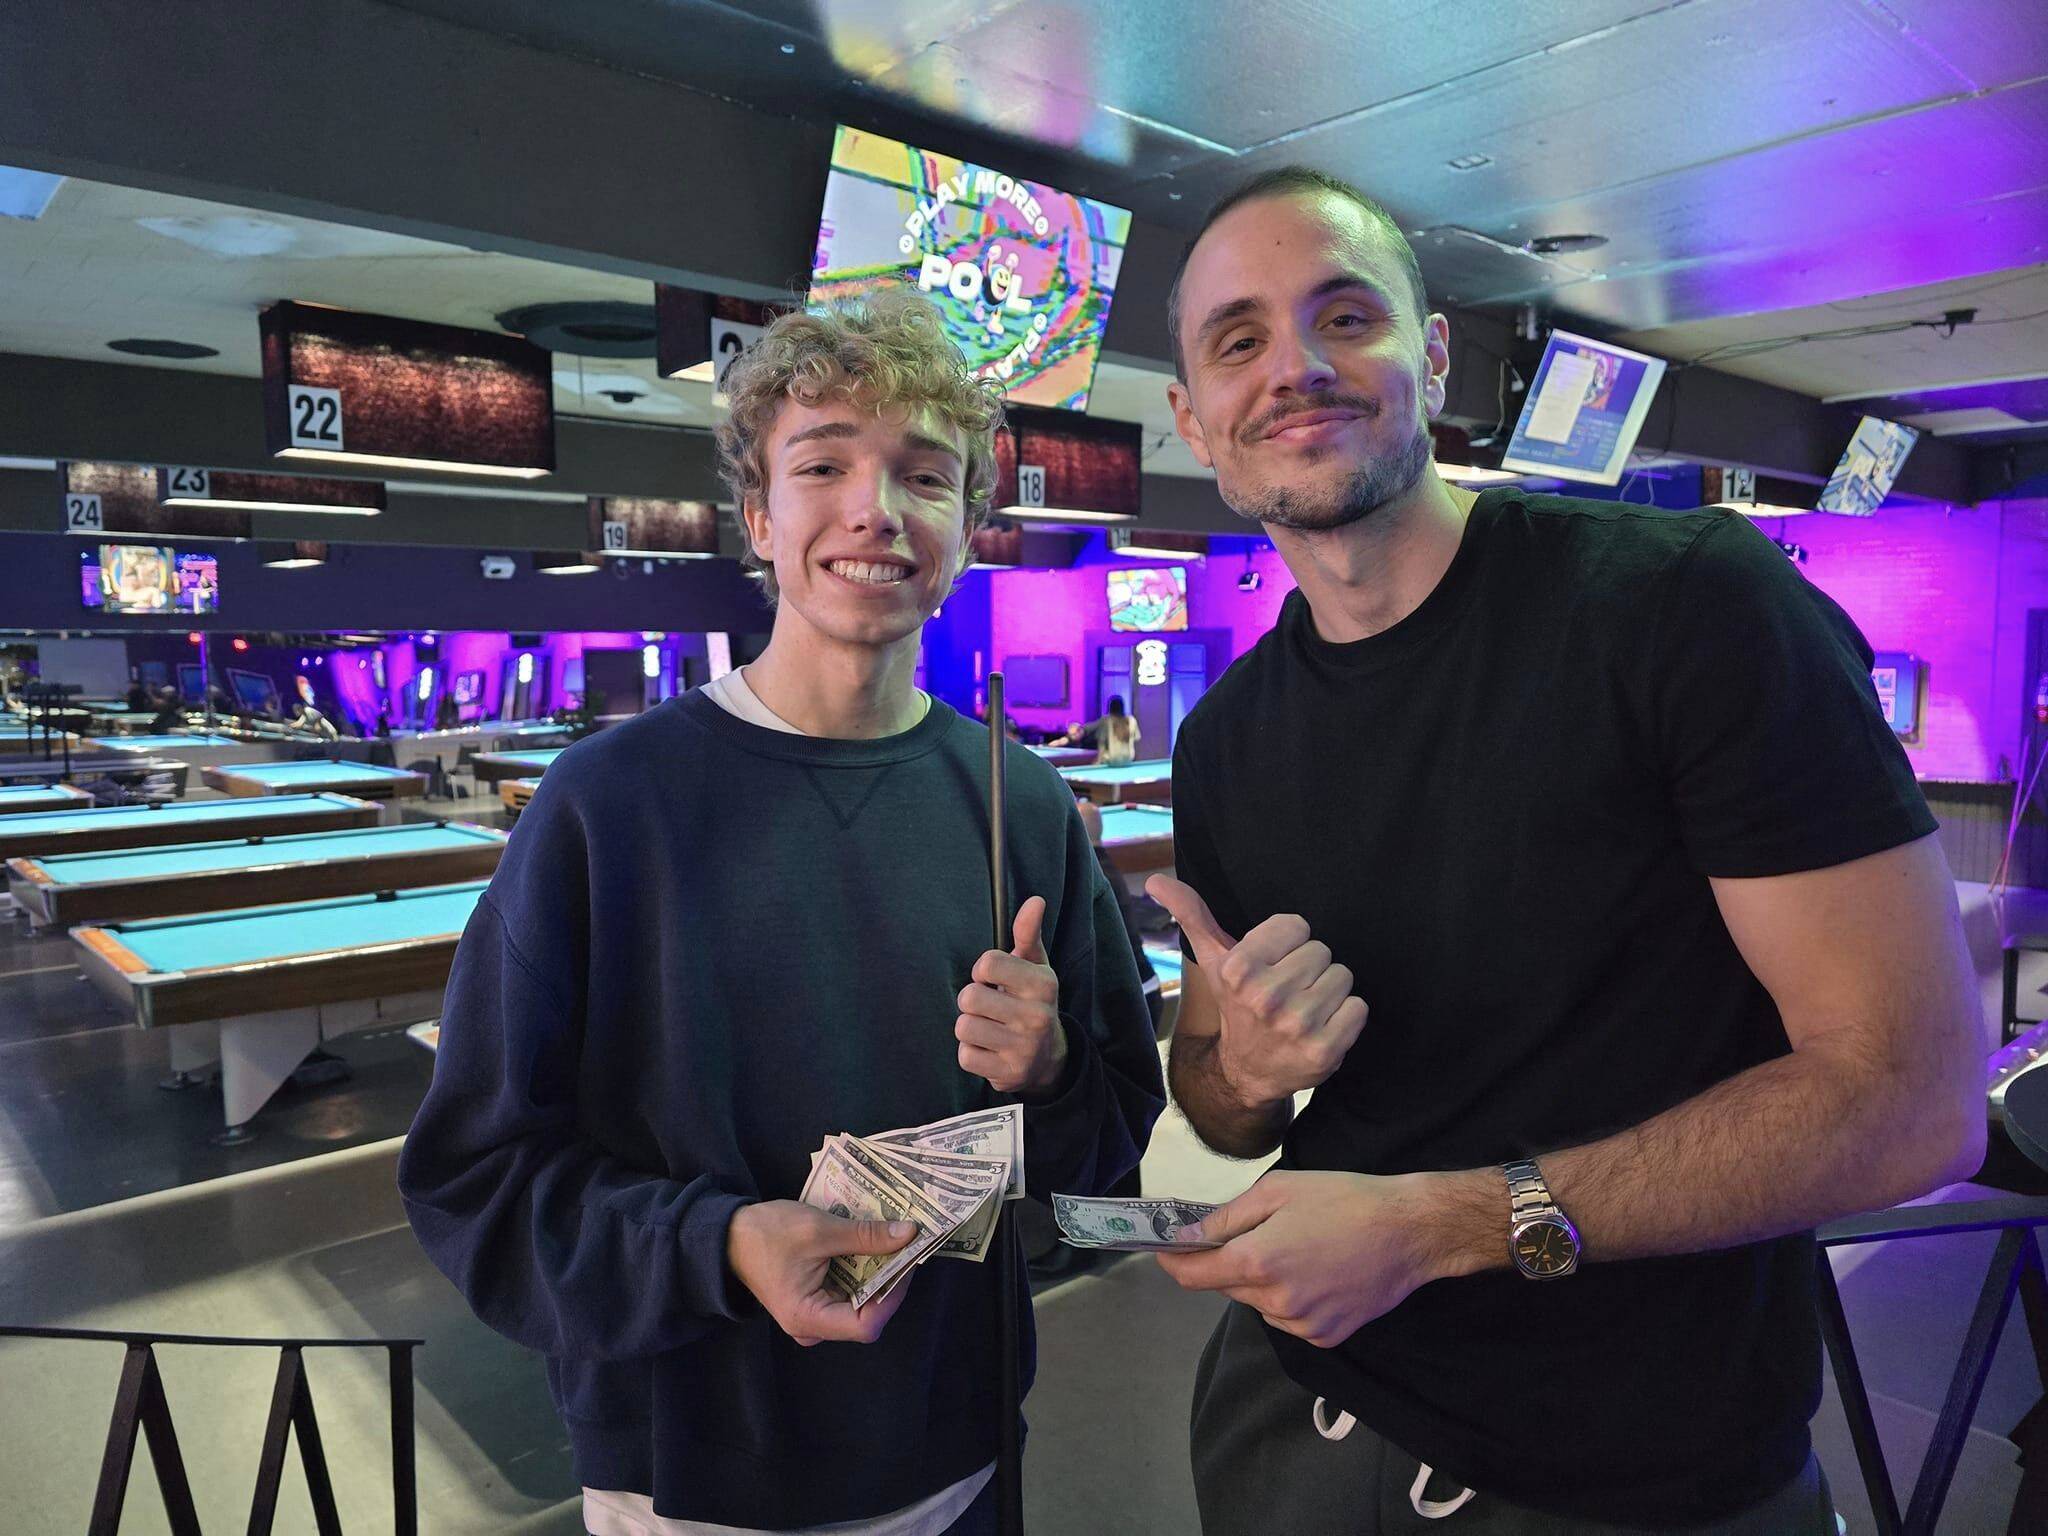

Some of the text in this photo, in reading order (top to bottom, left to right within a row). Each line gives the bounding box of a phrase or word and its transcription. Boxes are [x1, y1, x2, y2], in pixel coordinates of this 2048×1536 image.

[905, 171, 1042, 238] PLAY MORE
[295, 394, 338, 442] 22
[172, 469, 206, 492] 23
[1021, 472, 1041, 502] 18
[1725, 469, 1752, 498] 12
[70, 499, 100, 526] 24
[605, 526, 624, 547] 19
[997, 1111, 1013, 1122] 5
[989, 1162, 1006, 1174] 5
